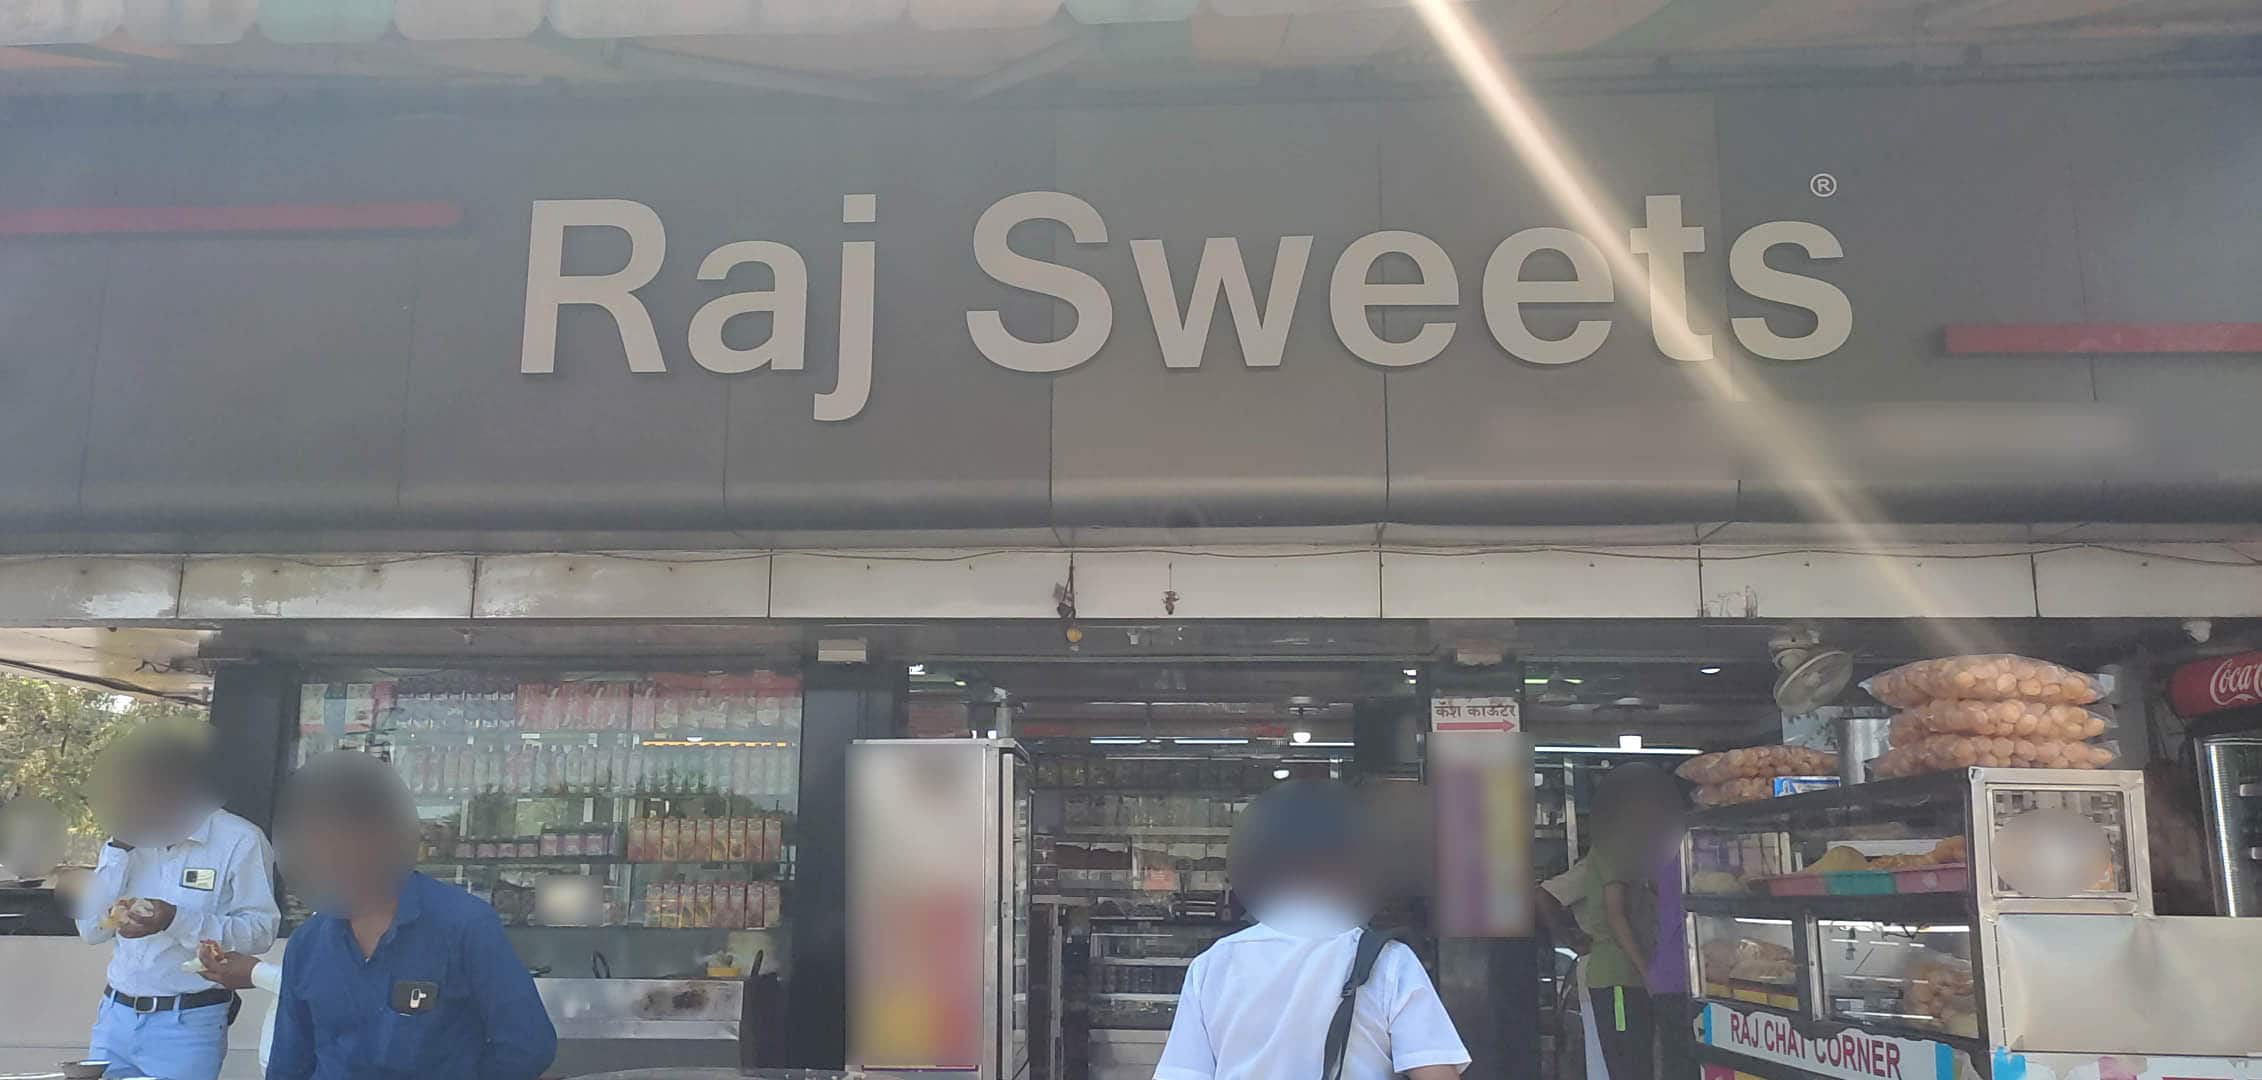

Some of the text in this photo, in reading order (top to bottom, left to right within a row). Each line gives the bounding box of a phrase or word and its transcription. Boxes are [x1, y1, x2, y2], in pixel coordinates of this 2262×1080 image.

[521, 191, 1853, 421] Raj Sweets
[1730, 1013, 1759, 1048] RAJ
[1814, 1034, 1902, 1080] CORNER
